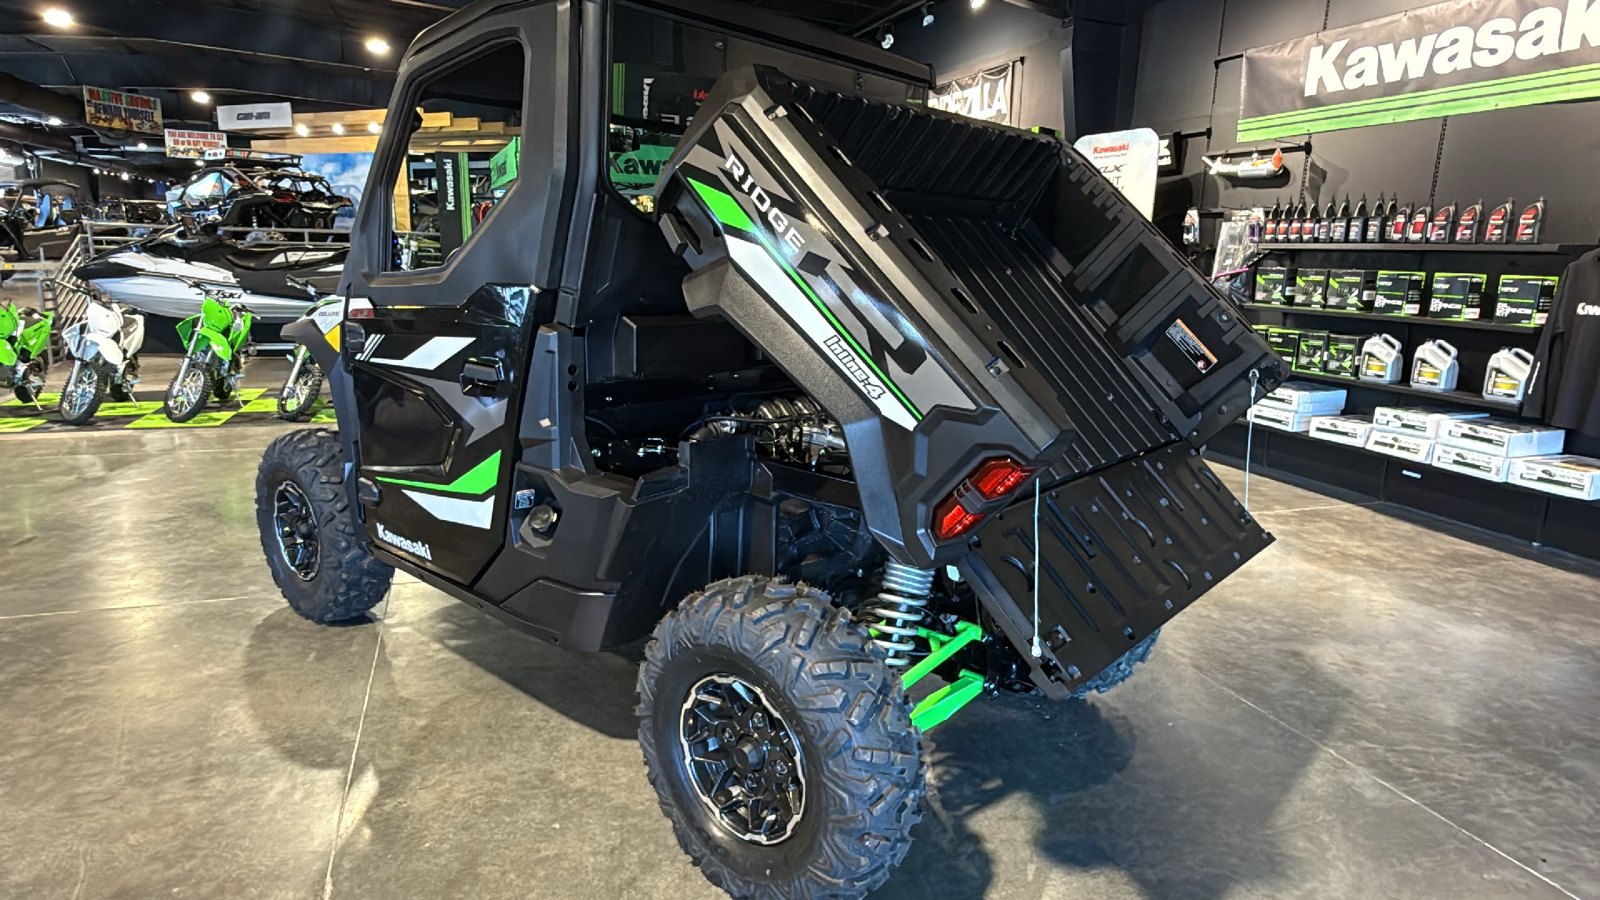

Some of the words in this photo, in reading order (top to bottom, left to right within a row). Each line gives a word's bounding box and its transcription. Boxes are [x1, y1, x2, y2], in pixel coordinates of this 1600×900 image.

[1093, 142, 1130, 154] Kawasaki
[443, 159, 455, 210] Kawasaki
[724, 154, 806, 254] RIDGE
[823, 334, 886, 400] Inline-4
[376, 522, 432, 560] Kawasaki
